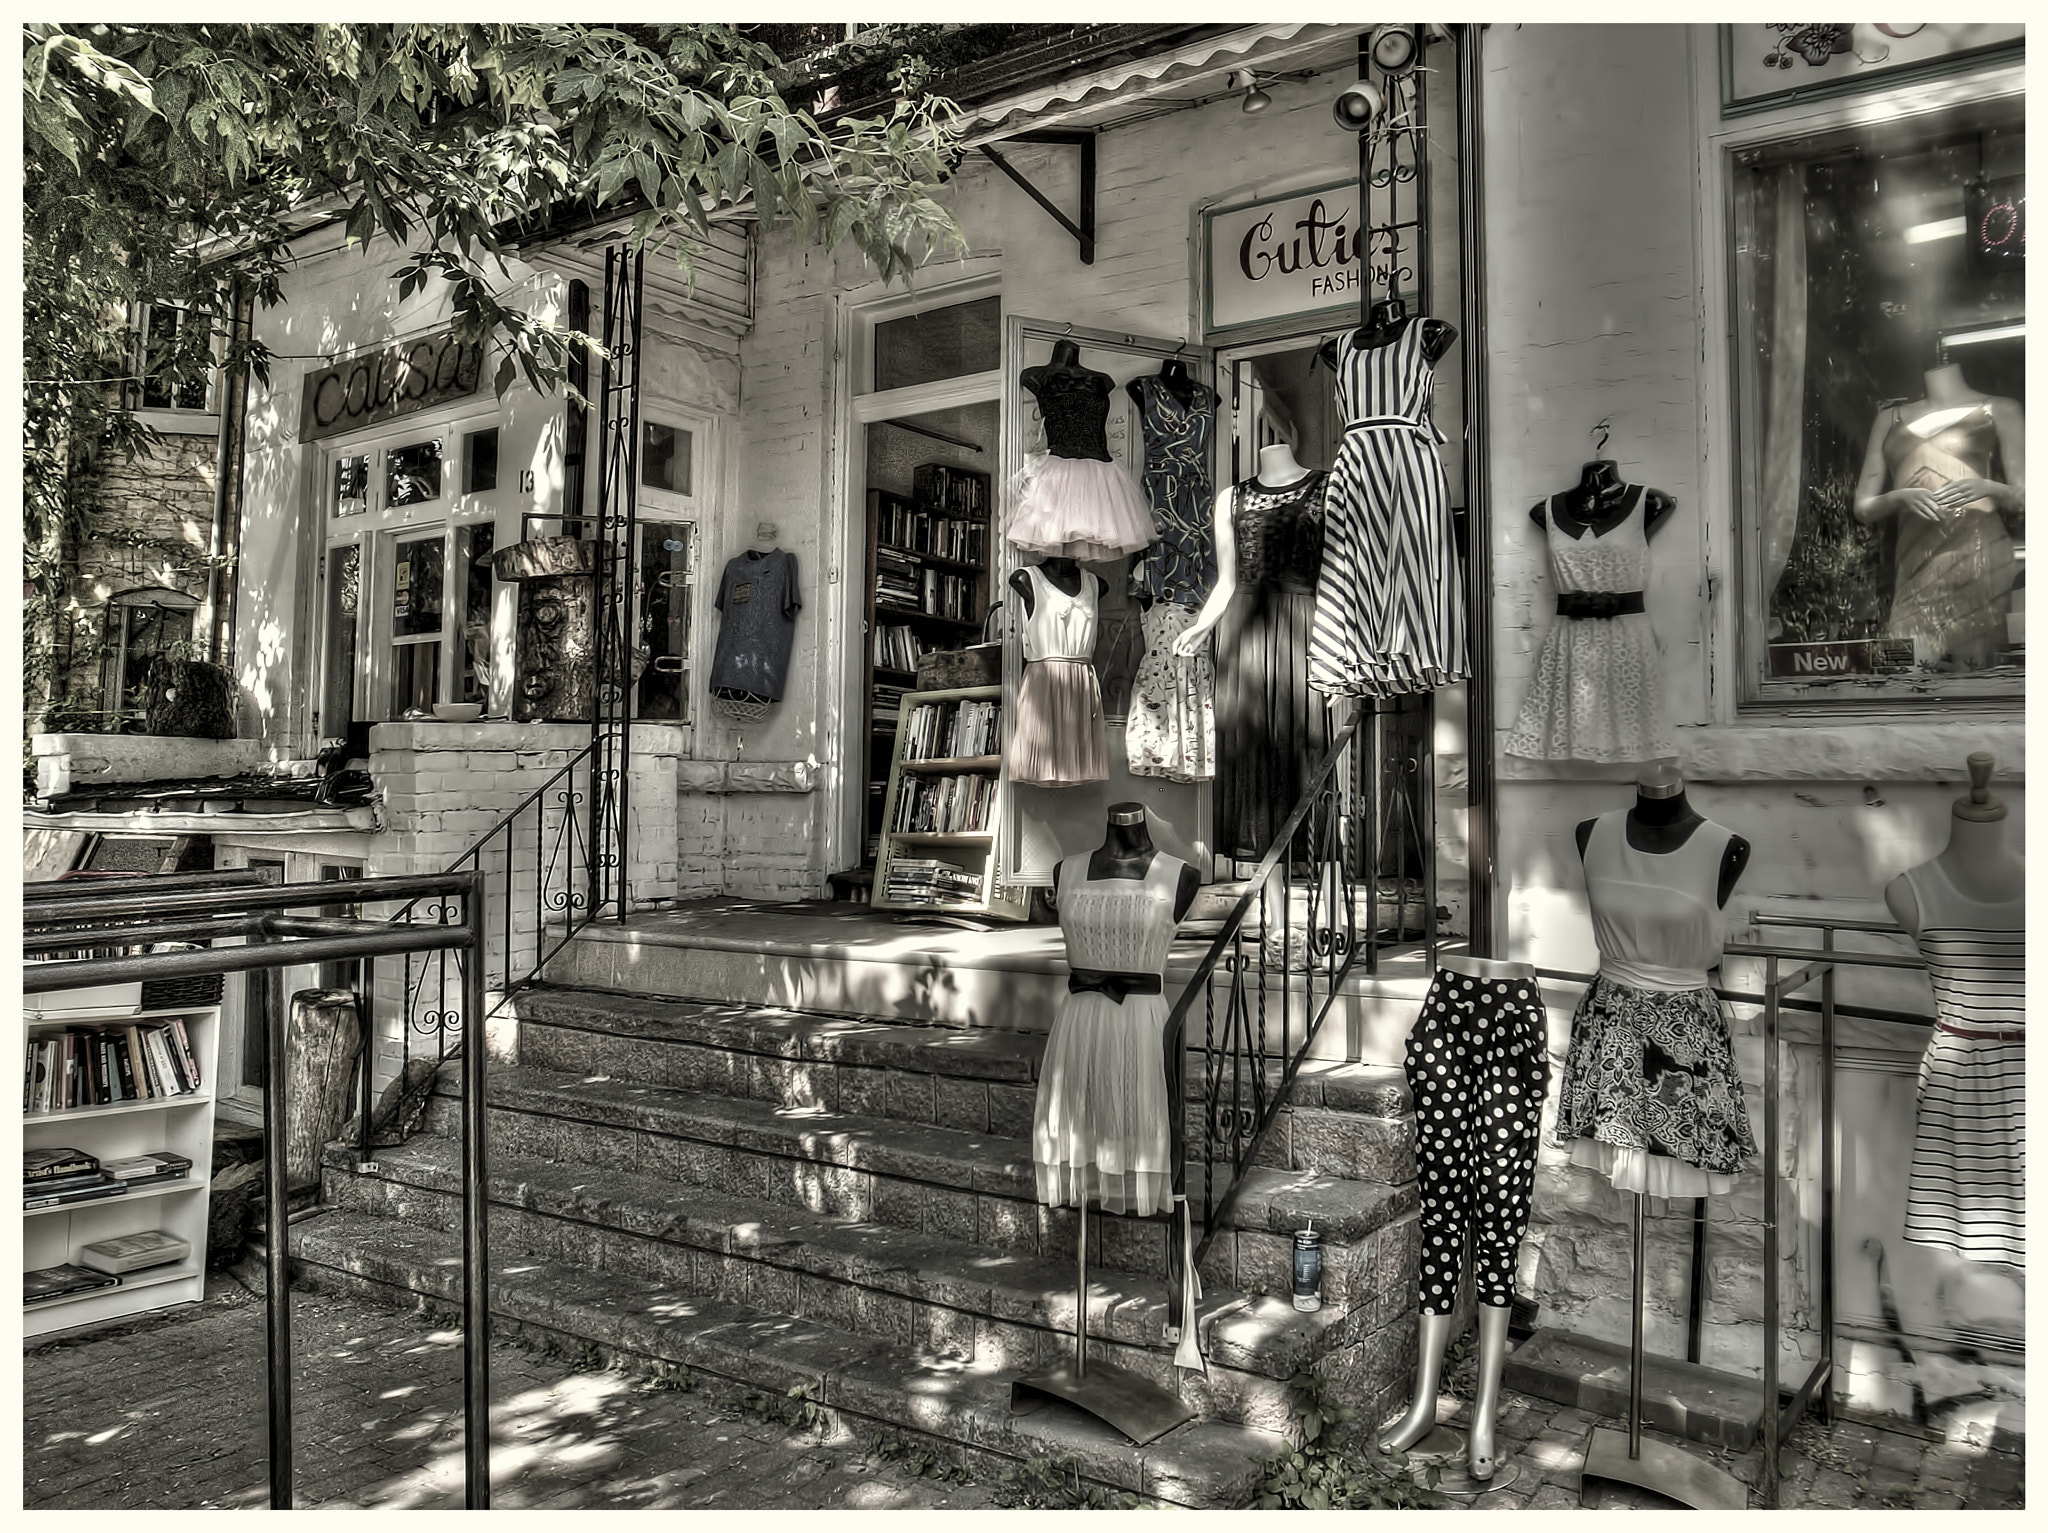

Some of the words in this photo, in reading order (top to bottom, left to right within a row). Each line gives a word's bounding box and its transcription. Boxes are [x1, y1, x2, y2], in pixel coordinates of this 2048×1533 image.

[1312, 264, 1389, 297] FASHON
[519, 470, 534, 493] 13
[1794, 652, 1848, 672] New
